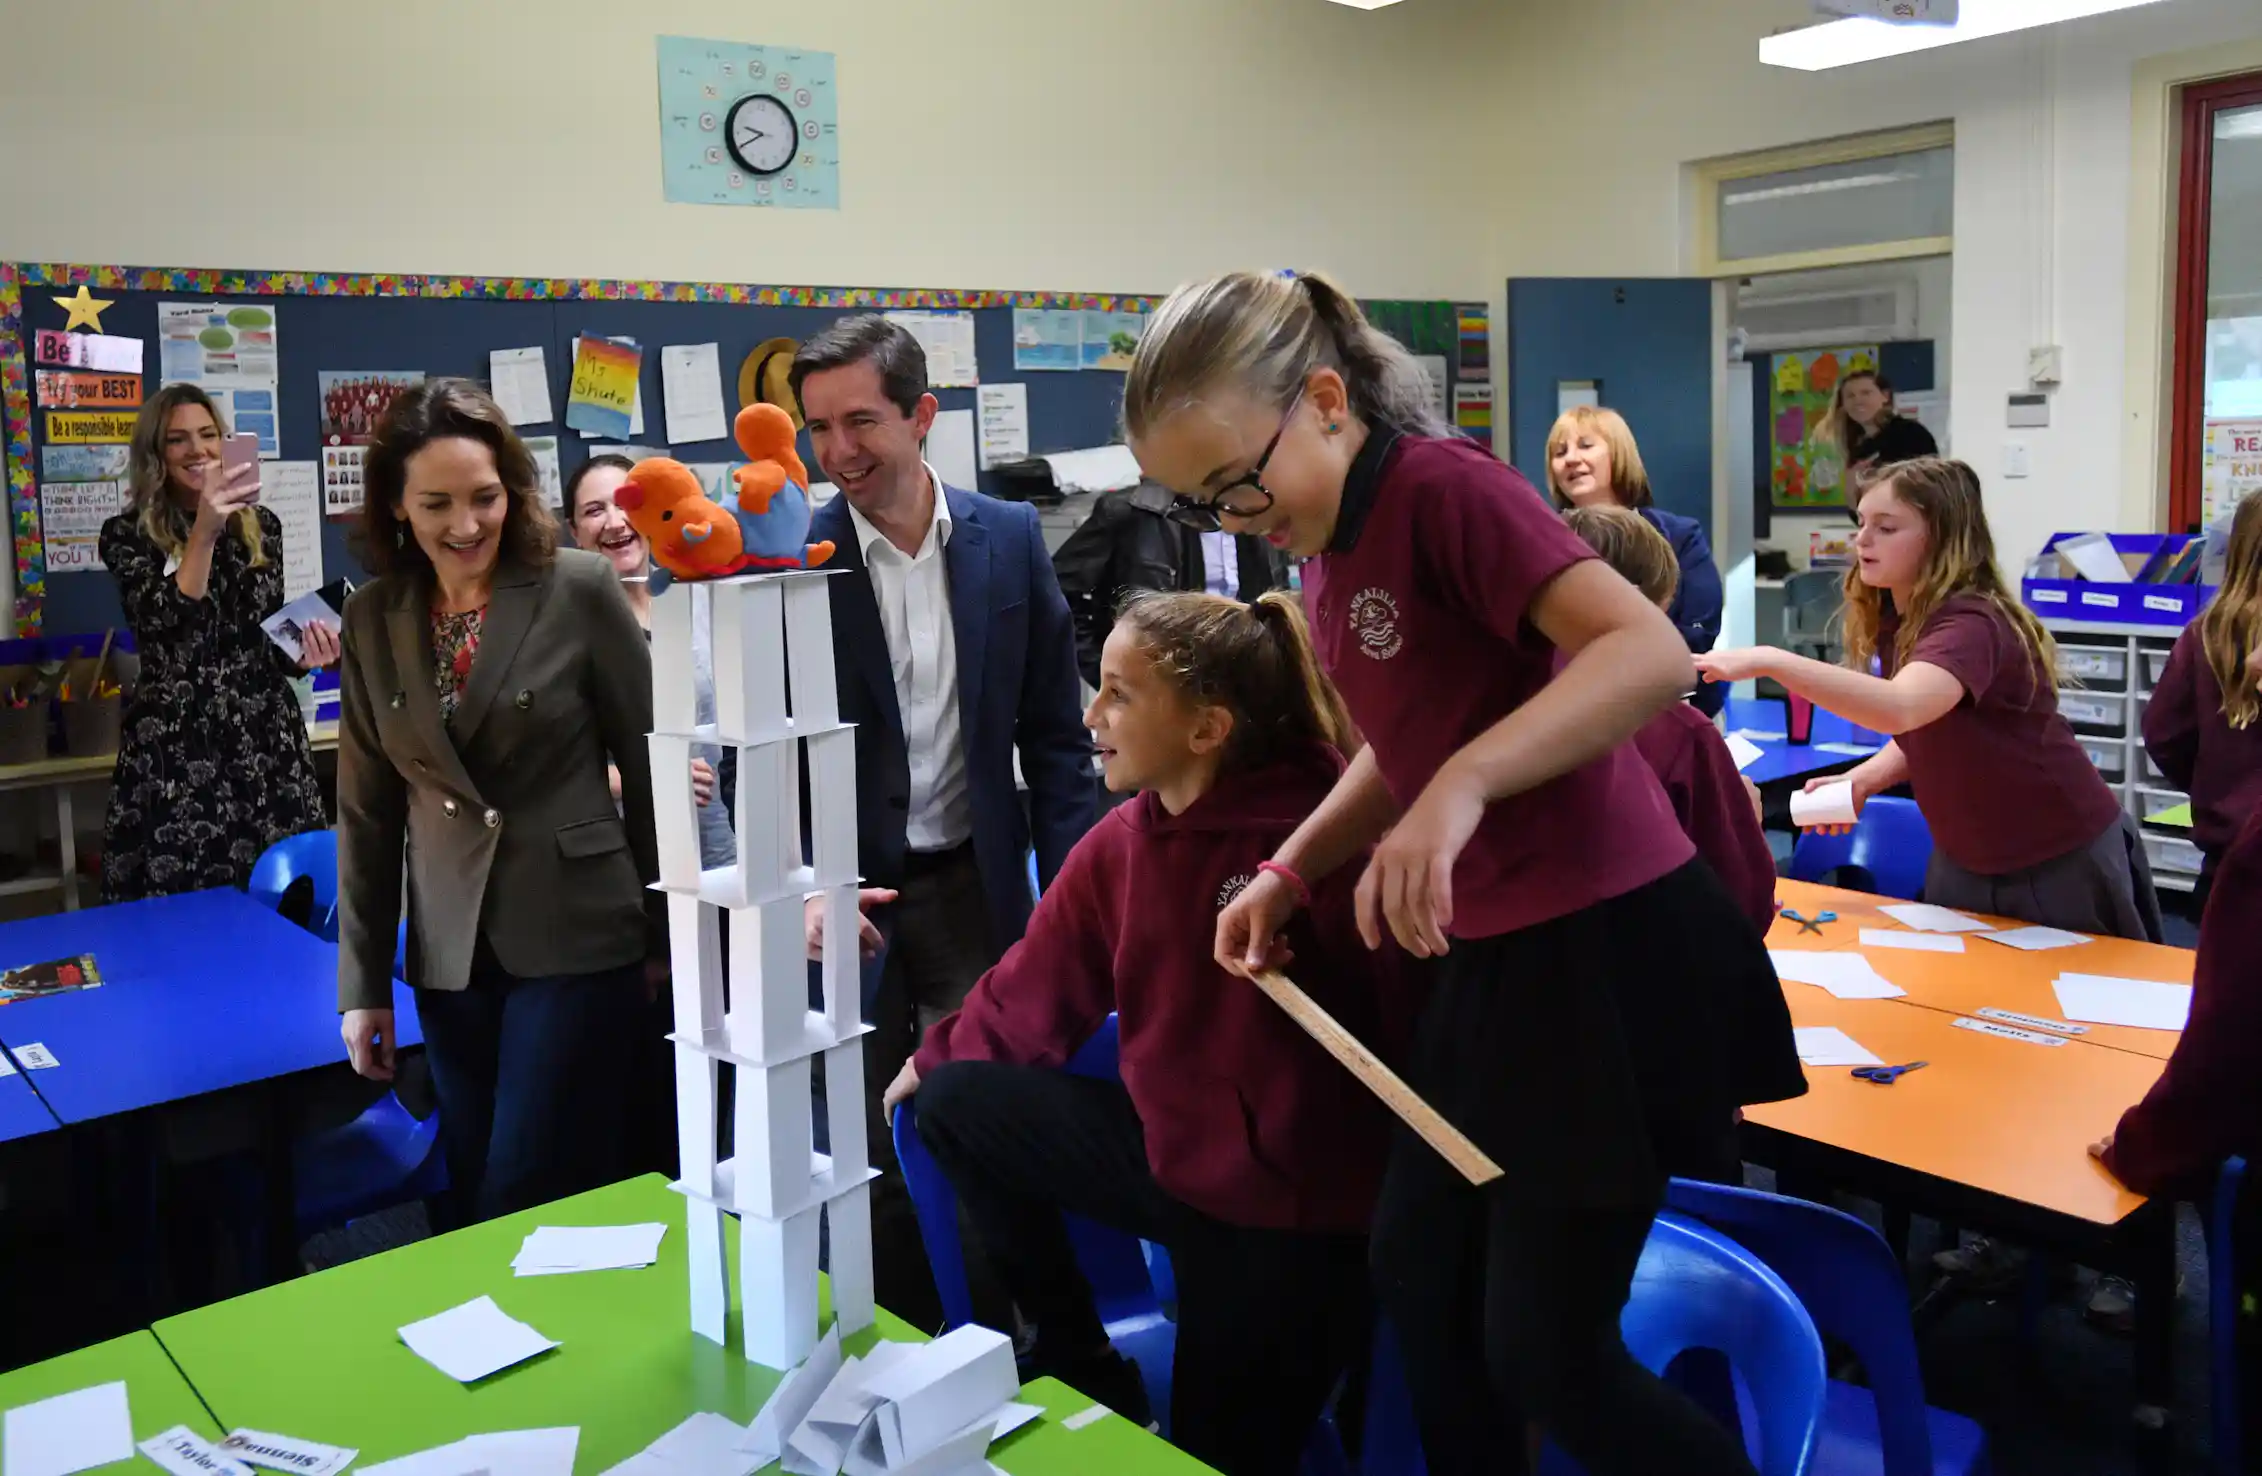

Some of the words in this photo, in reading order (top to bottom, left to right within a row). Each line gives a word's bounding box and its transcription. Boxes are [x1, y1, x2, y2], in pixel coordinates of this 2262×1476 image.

[43, 335, 71, 362] Be
[102, 380, 136, 400] BEST
[574, 376, 627, 405] Shute
[52, 416, 63, 437] Be
[64, 421, 70, 437] a
[72, 416, 115, 438] responsible
[2234, 437, 2262, 453] RE
[47, 550, 82, 565] YOU
[175, 1441, 218, 1470] Taylor
